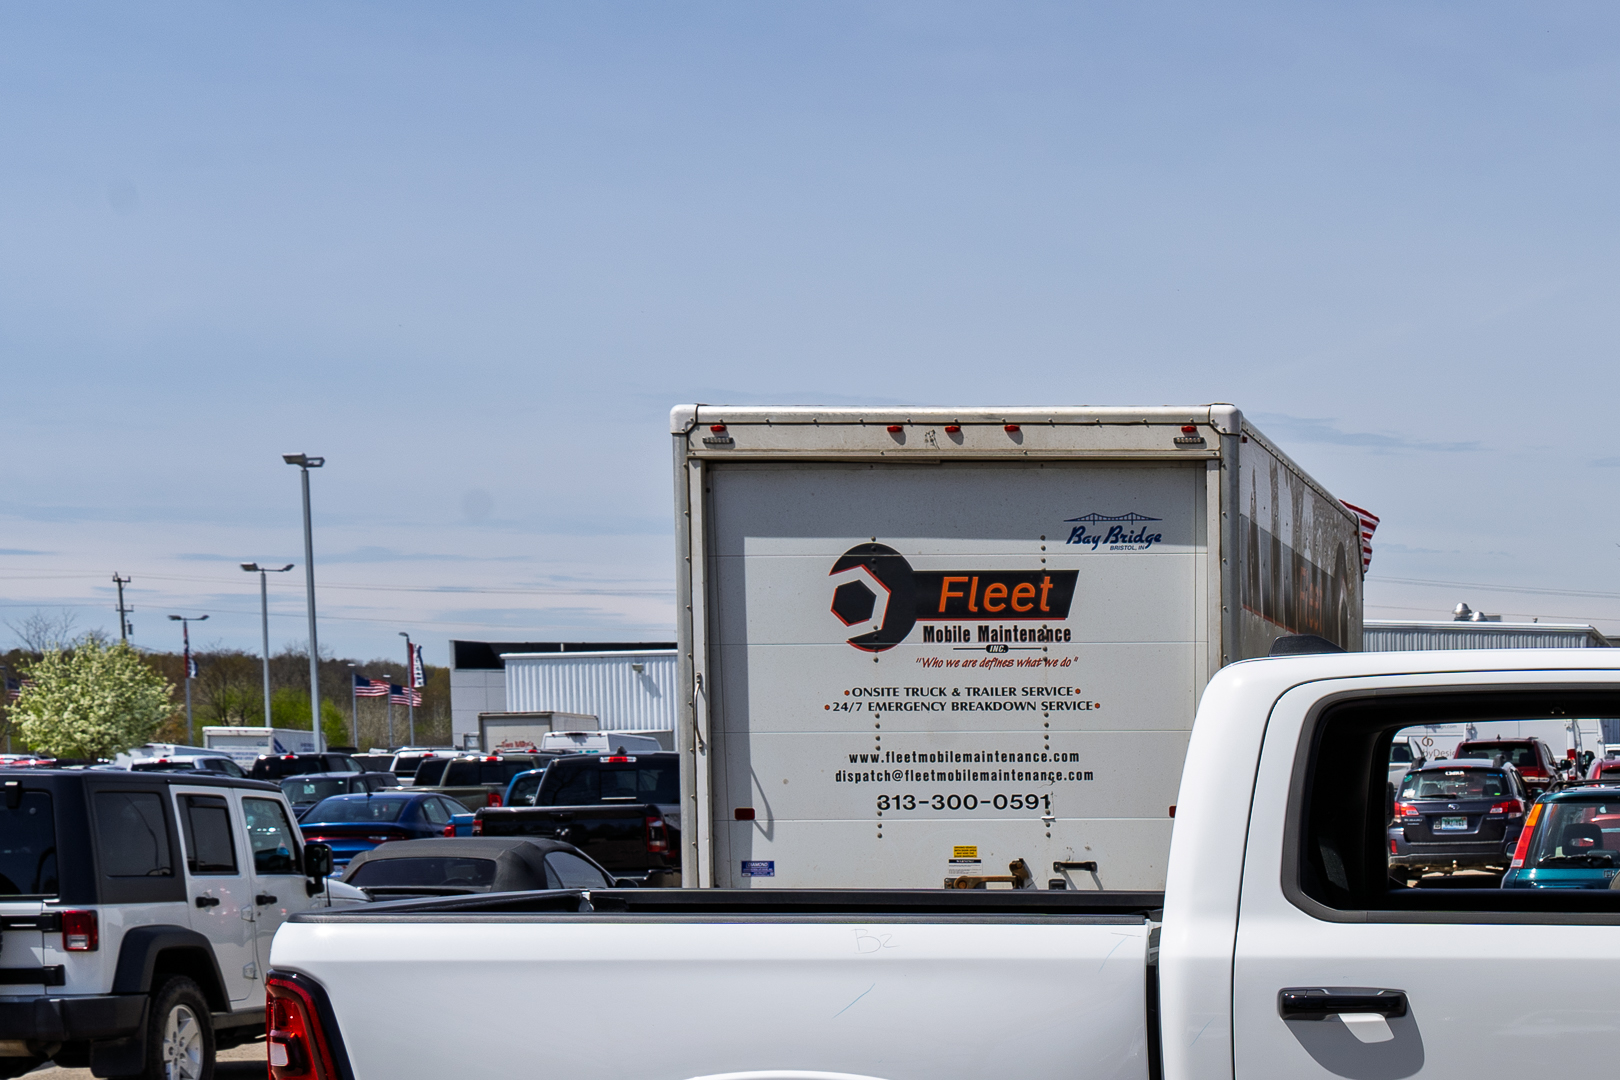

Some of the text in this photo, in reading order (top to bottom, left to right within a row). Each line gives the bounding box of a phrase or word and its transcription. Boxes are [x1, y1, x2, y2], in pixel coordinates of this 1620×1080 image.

[1065, 525, 1162, 550] Bay Bridge
[938, 576, 1053, 612] Fleet
[922, 625, 1072, 643] Mobile Maintenance
[945, 659, 960, 667] we
[962, 659, 977, 667] are
[979, 657, 1014, 670] defines
[1016, 657, 1043, 668] what
[1045, 659, 1058, 668] we
[852, 686, 1073, 697] ONSITE TRUCK & TRAILER SERVICE
[833, 701, 1093, 712] 24/7 EMERGENCY BREAKDOWN SERVICE
[849, 751, 1080, 763] www.fleetmobilemaintenance.com
[835, 769, 1094, 784] dispatch@fleetmobilemaintenance.com
[877, 794, 1050, 811] 313-300-0591
